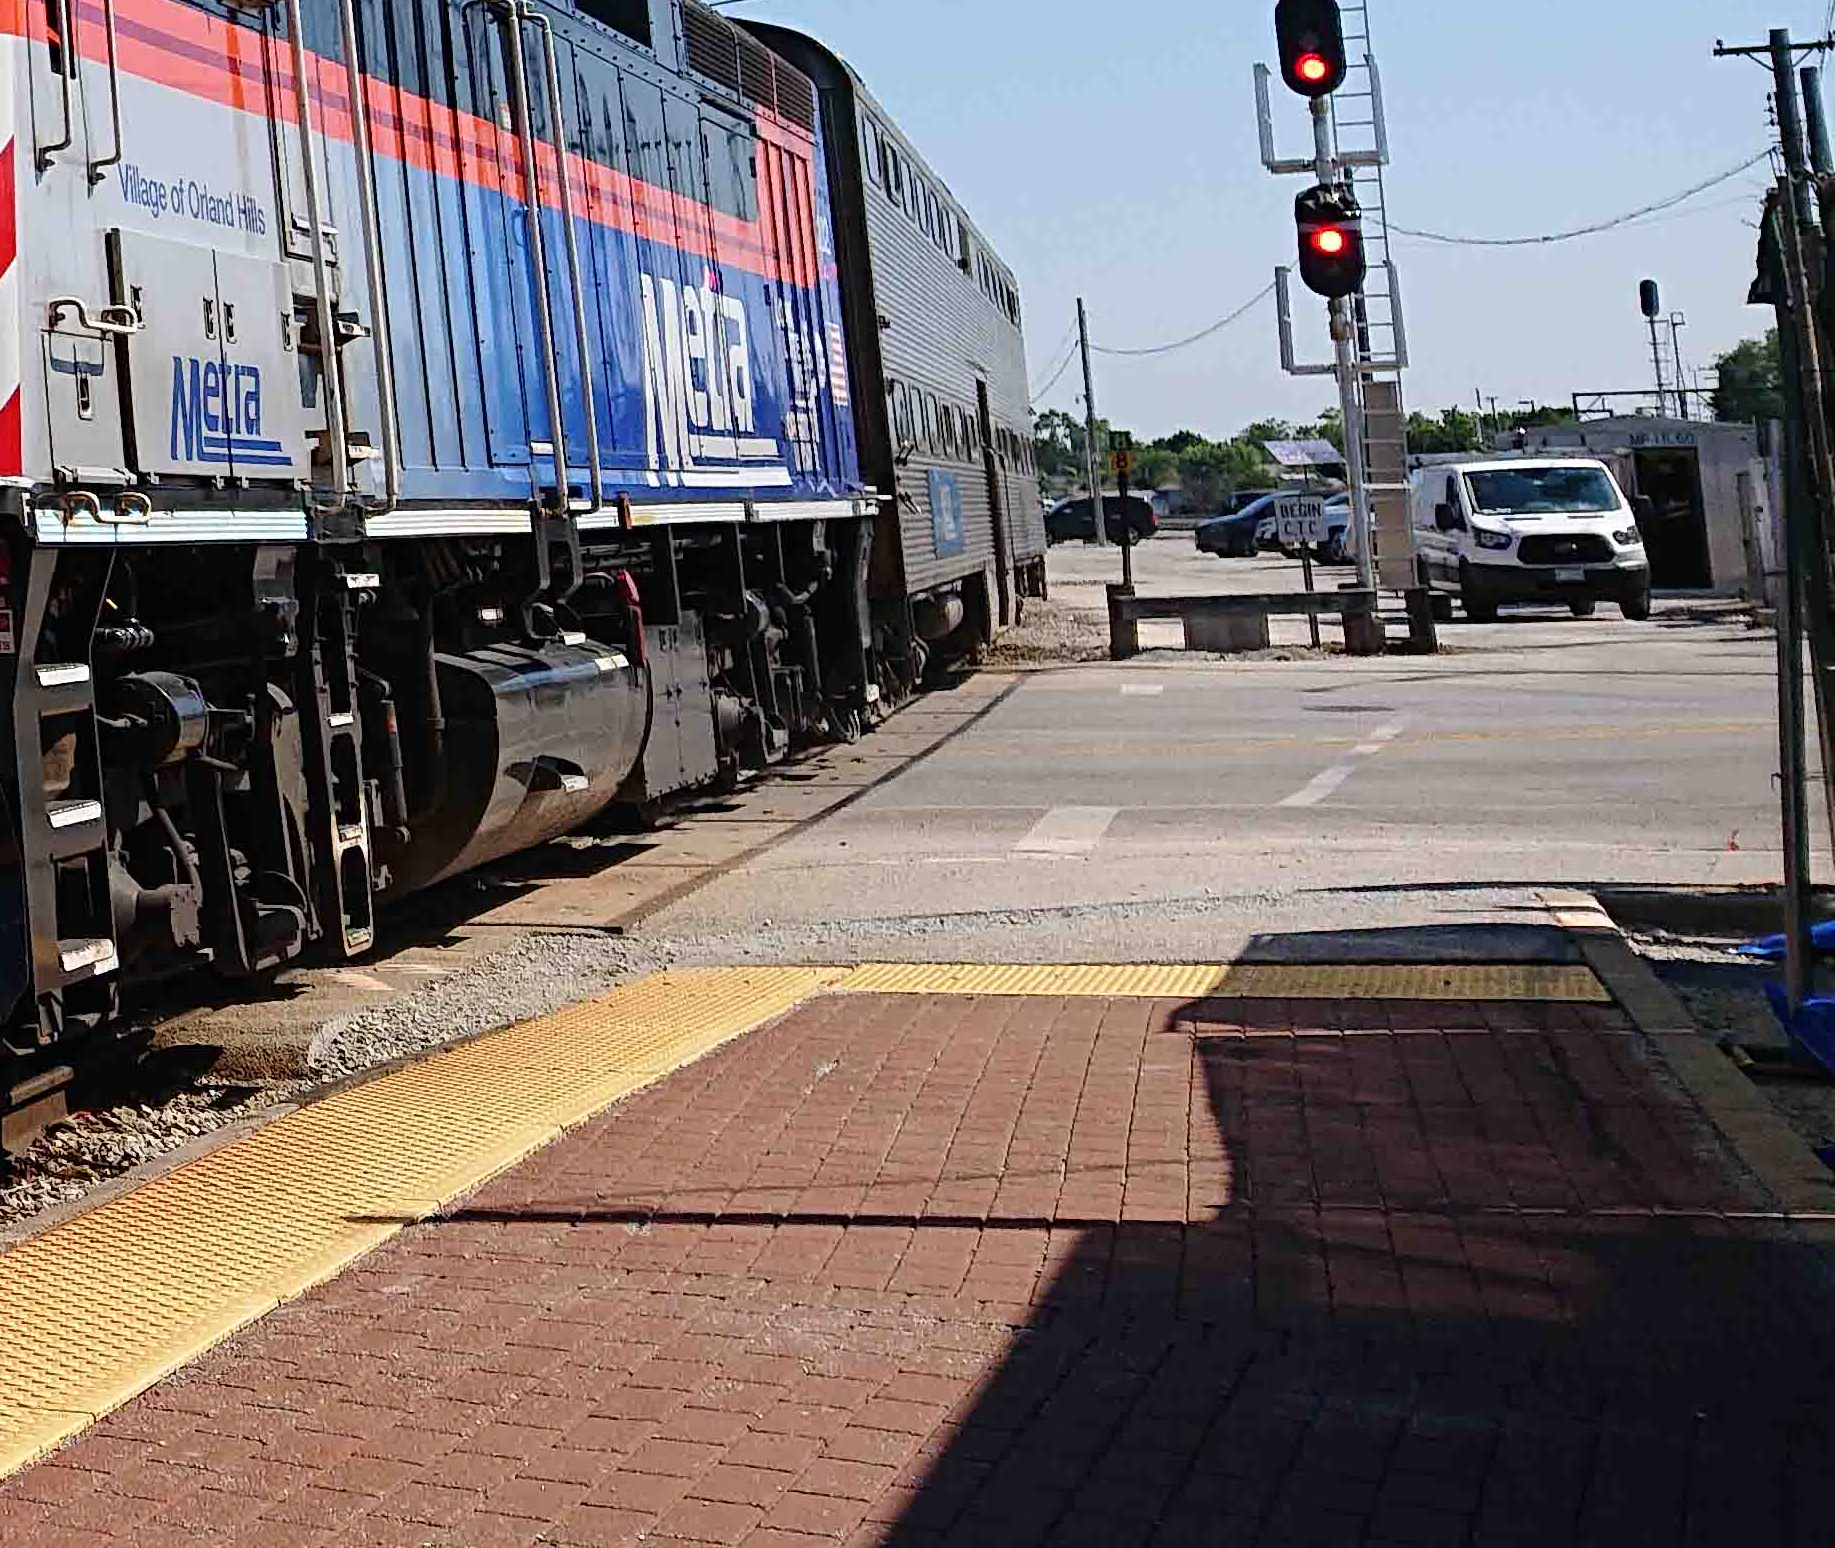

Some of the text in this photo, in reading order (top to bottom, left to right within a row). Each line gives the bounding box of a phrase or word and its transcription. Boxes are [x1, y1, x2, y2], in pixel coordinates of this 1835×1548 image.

[118, 163, 266, 235] Village of Orland Hills
[1280, 503, 1321, 517] BEGIN
